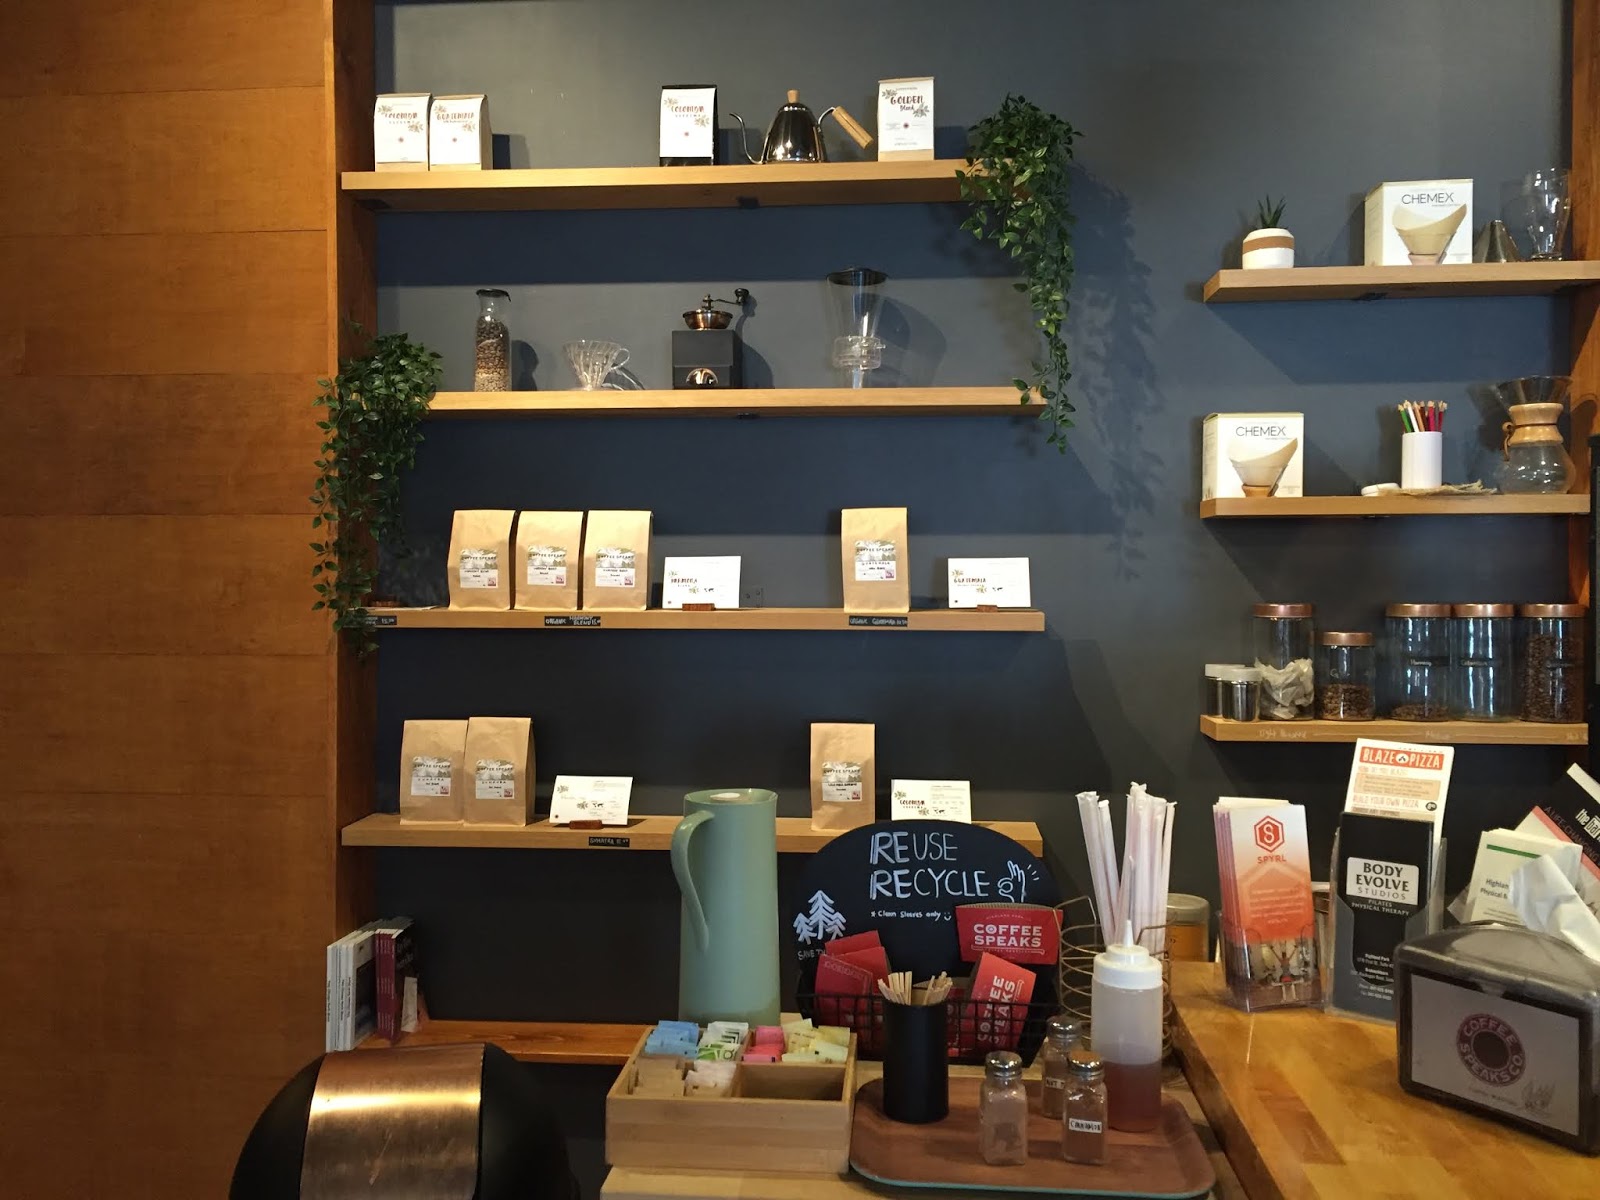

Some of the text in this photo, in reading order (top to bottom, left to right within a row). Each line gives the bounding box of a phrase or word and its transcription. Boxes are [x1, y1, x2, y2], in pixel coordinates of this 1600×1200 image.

[890, 95, 923, 105] GOLDEN
[1401, 192, 1454, 205] CHEMEX
[1235, 426, 1287, 437] CHEMEX
[1362, 747, 1441, 770] BLAZE PIZZA
[1402, 799, 1419, 808] PIZZA
[1575, 808, 1590, 826] the
[870, 832, 958, 864] REUSE
[1257, 854, 1287, 864] SPYRL
[1363, 862, 1403, 878] BODY
[870, 868, 990, 900] RECYCLE
[1356, 874, 1410, 892] EVOLVE
[1486, 878, 1509, 889] Highlan
[1358, 886, 1406, 900] STUDIOS
[1351, 902, 1410, 917] PHYSICAL THERAPY
[1368, 899, 1393, 908] PILATES
[926, 911, 941, 921] only
[973, 923, 1043, 937] COFFEE
[974, 935, 1041, 948] SPEAKS
[797, 949, 815, 960] SAVE
[1463, 1018, 1518, 1046] COFFEE
[1460, 1043, 1511, 1083] SPEAKS
